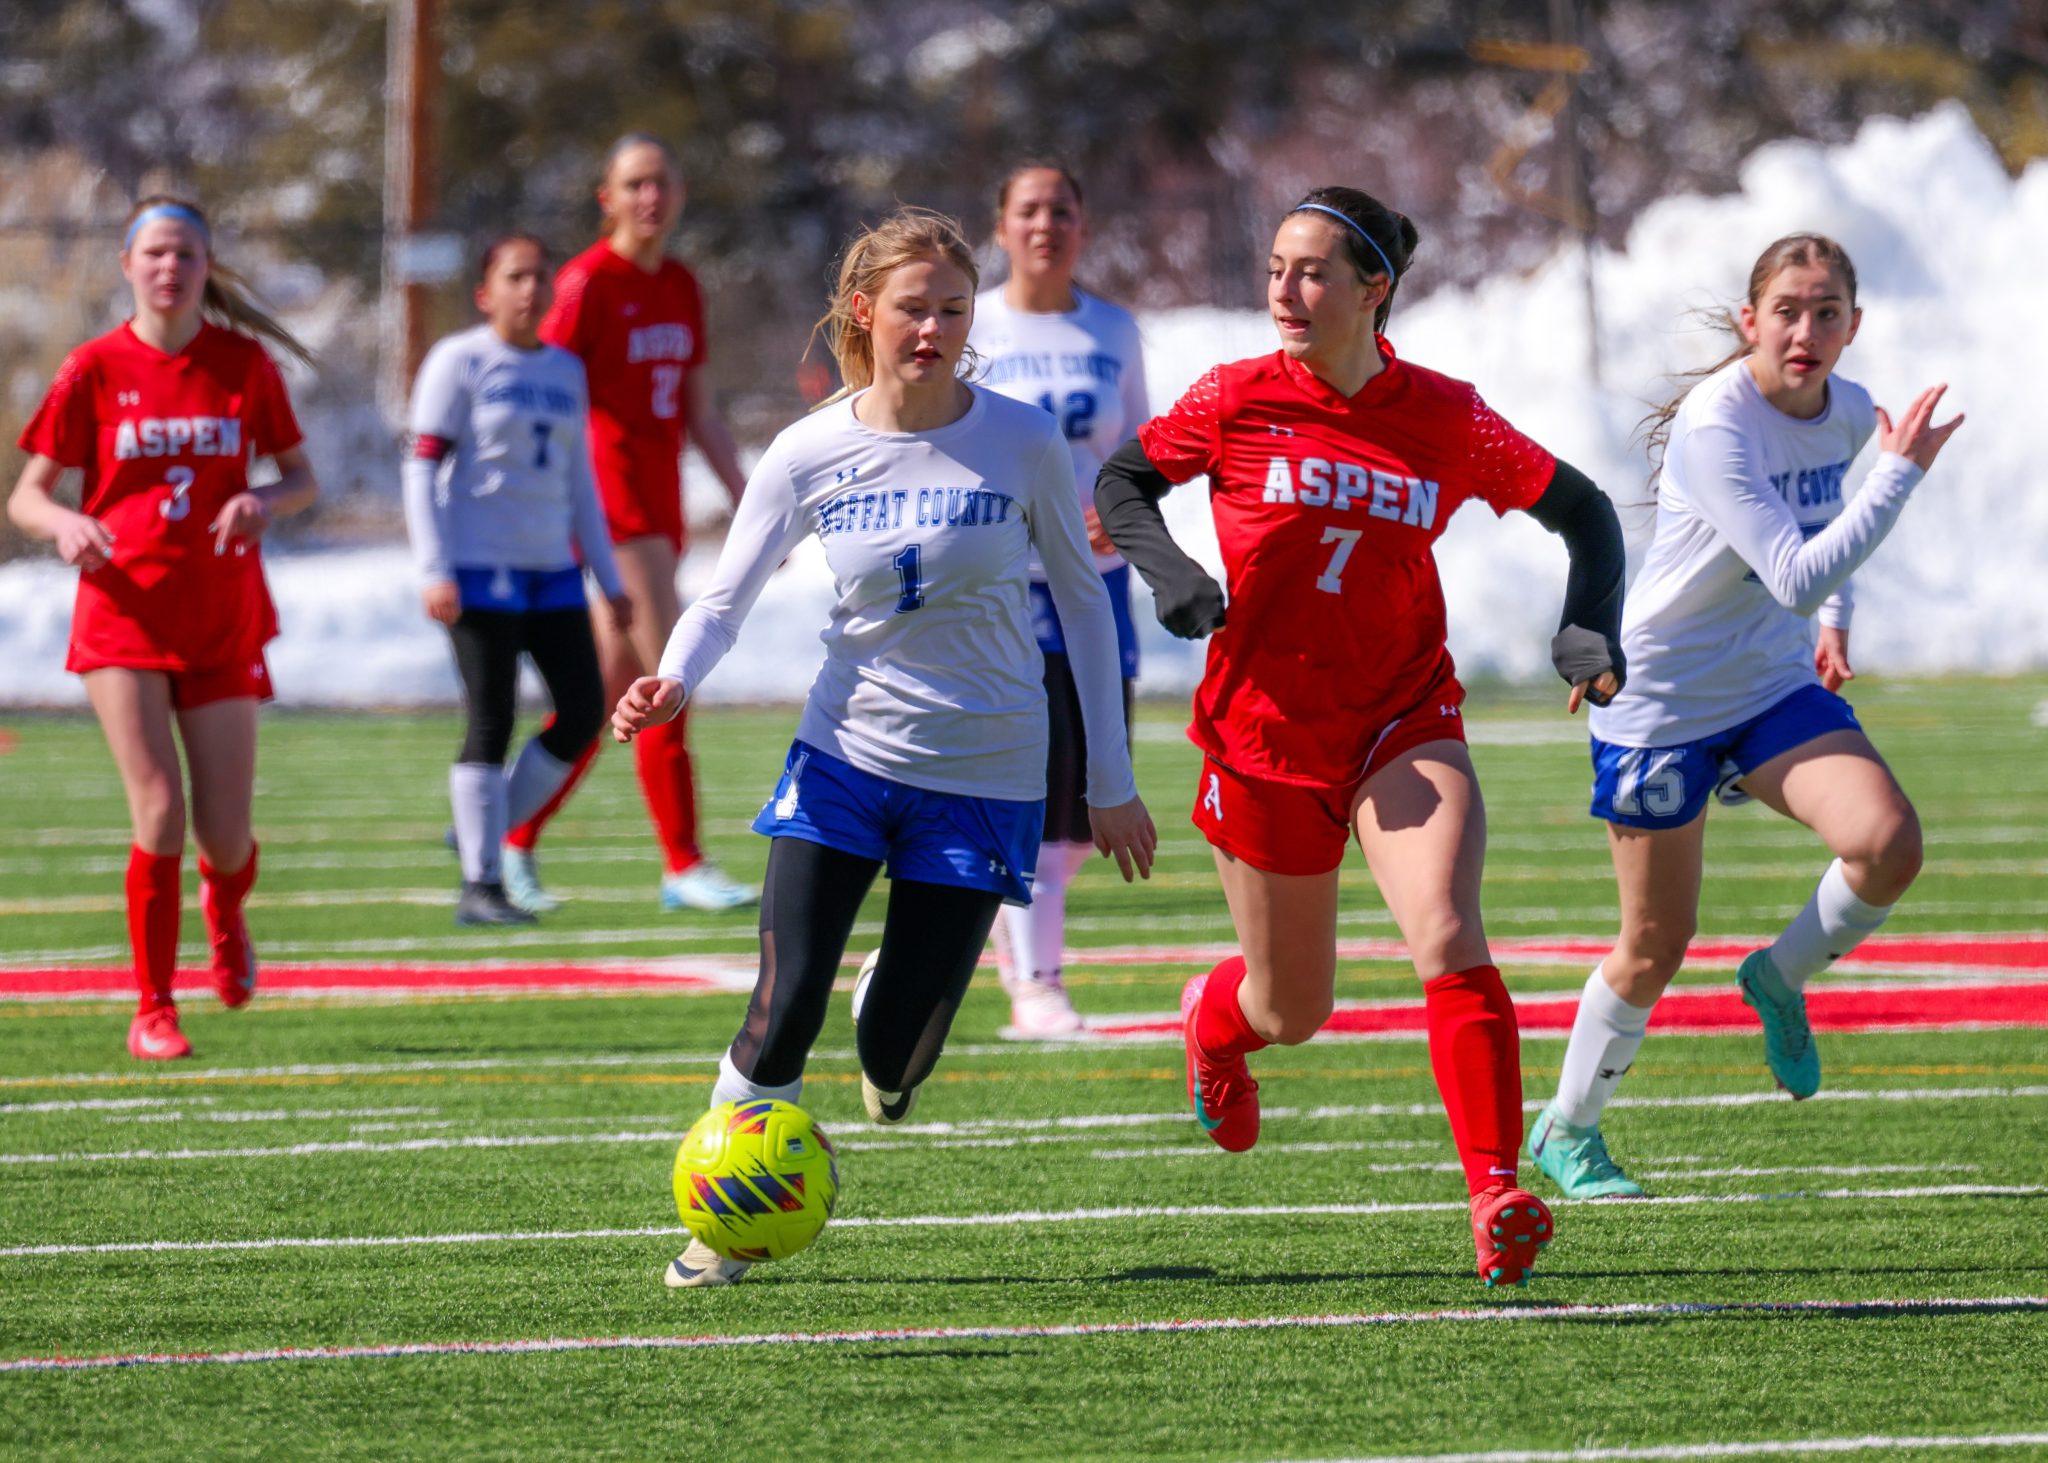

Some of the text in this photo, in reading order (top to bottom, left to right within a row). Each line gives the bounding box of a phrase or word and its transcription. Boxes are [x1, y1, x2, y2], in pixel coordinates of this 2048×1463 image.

[114, 414, 242, 462] ASPEN
[1038, 385, 1097, 439] 12
[158, 463, 196, 522] 3
[915, 487, 1014, 527] COUNTY
[1262, 456, 1440, 530] ASPEN
[893, 543, 926, 614] 1
[1315, 525, 1364, 595] 7
[775, 751, 811, 820] 1
[1203, 773, 1224, 821] A
[1612, 748, 1687, 817] 15
